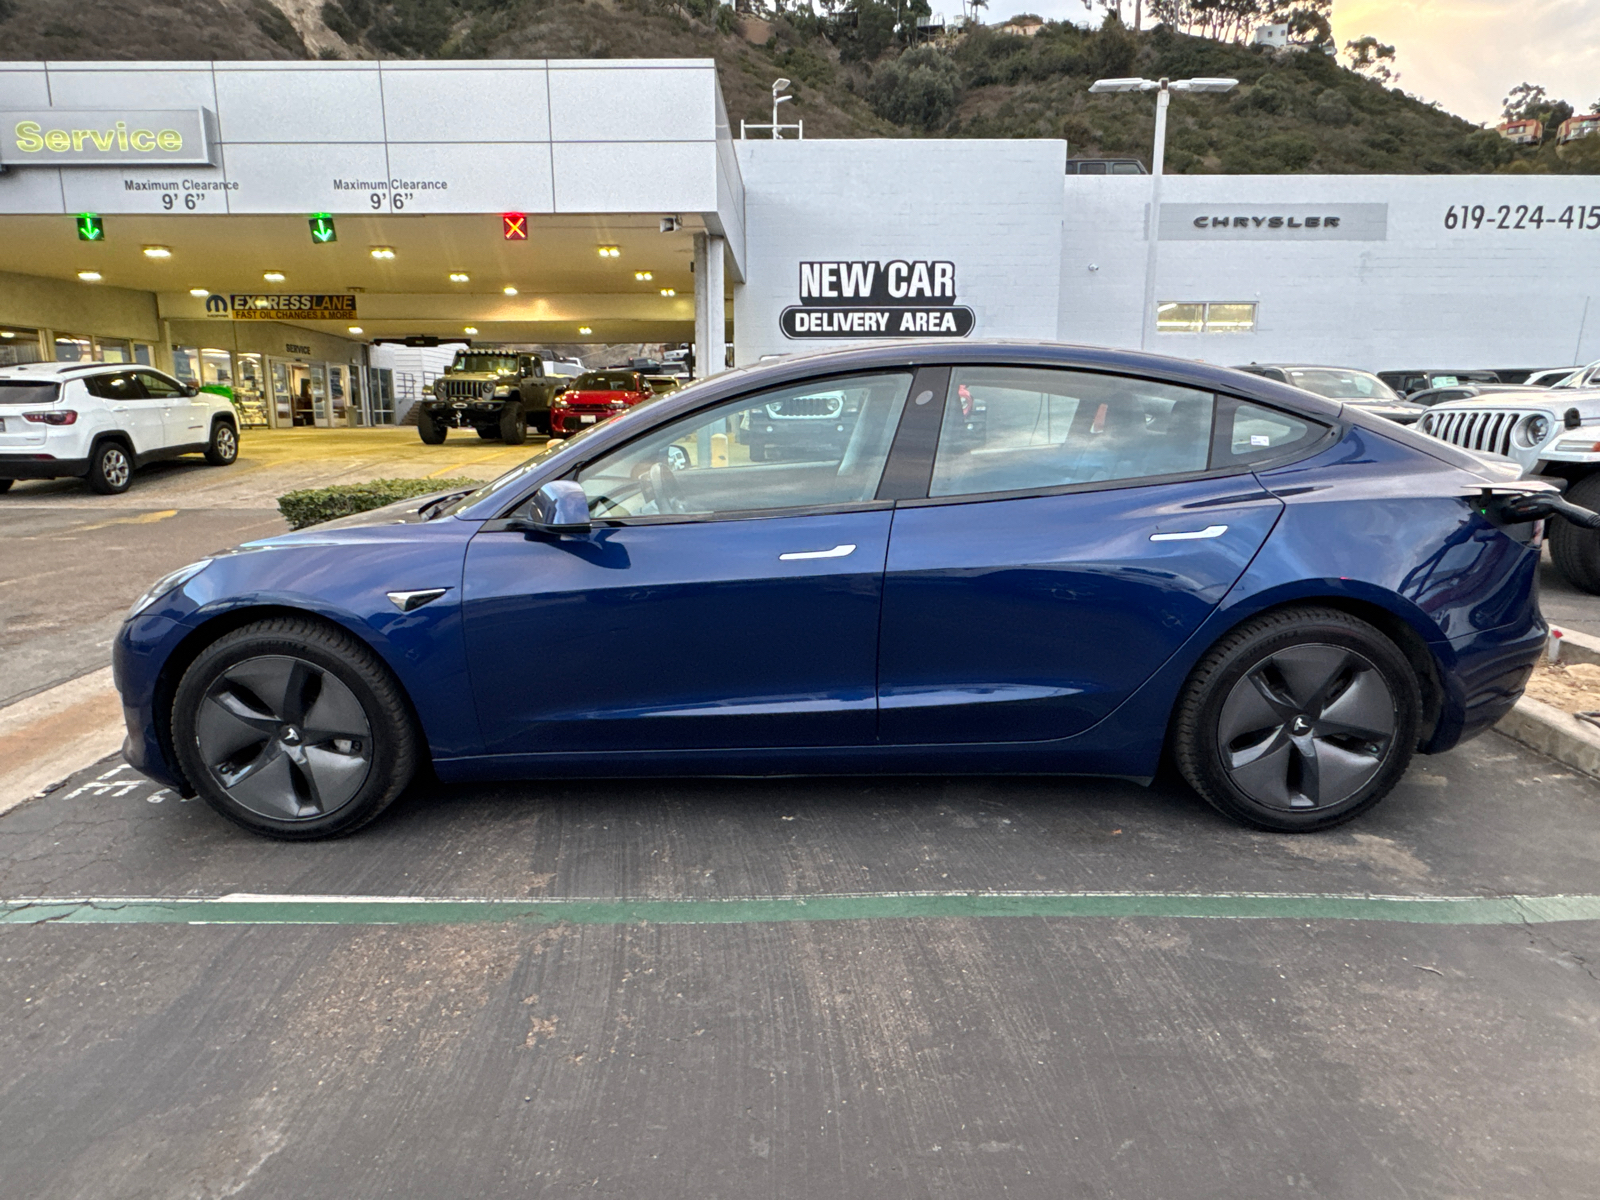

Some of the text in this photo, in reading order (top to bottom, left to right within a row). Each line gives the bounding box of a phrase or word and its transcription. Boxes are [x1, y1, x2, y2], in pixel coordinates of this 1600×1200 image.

[15, 121, 183, 152] Service
[124, 179, 239, 190] Maximum Clearance
[333, 179, 448, 190] Maximum Clearance
[1193, 216, 1340, 229] CHRYSLER
[801, 262, 954, 298] NEW CAR
[236, 311, 354, 319] FAST OIL CHANGES & MORE
[795, 312, 957, 332] DELIVERY AREA
[286, 344, 311, 355] SERVICE
